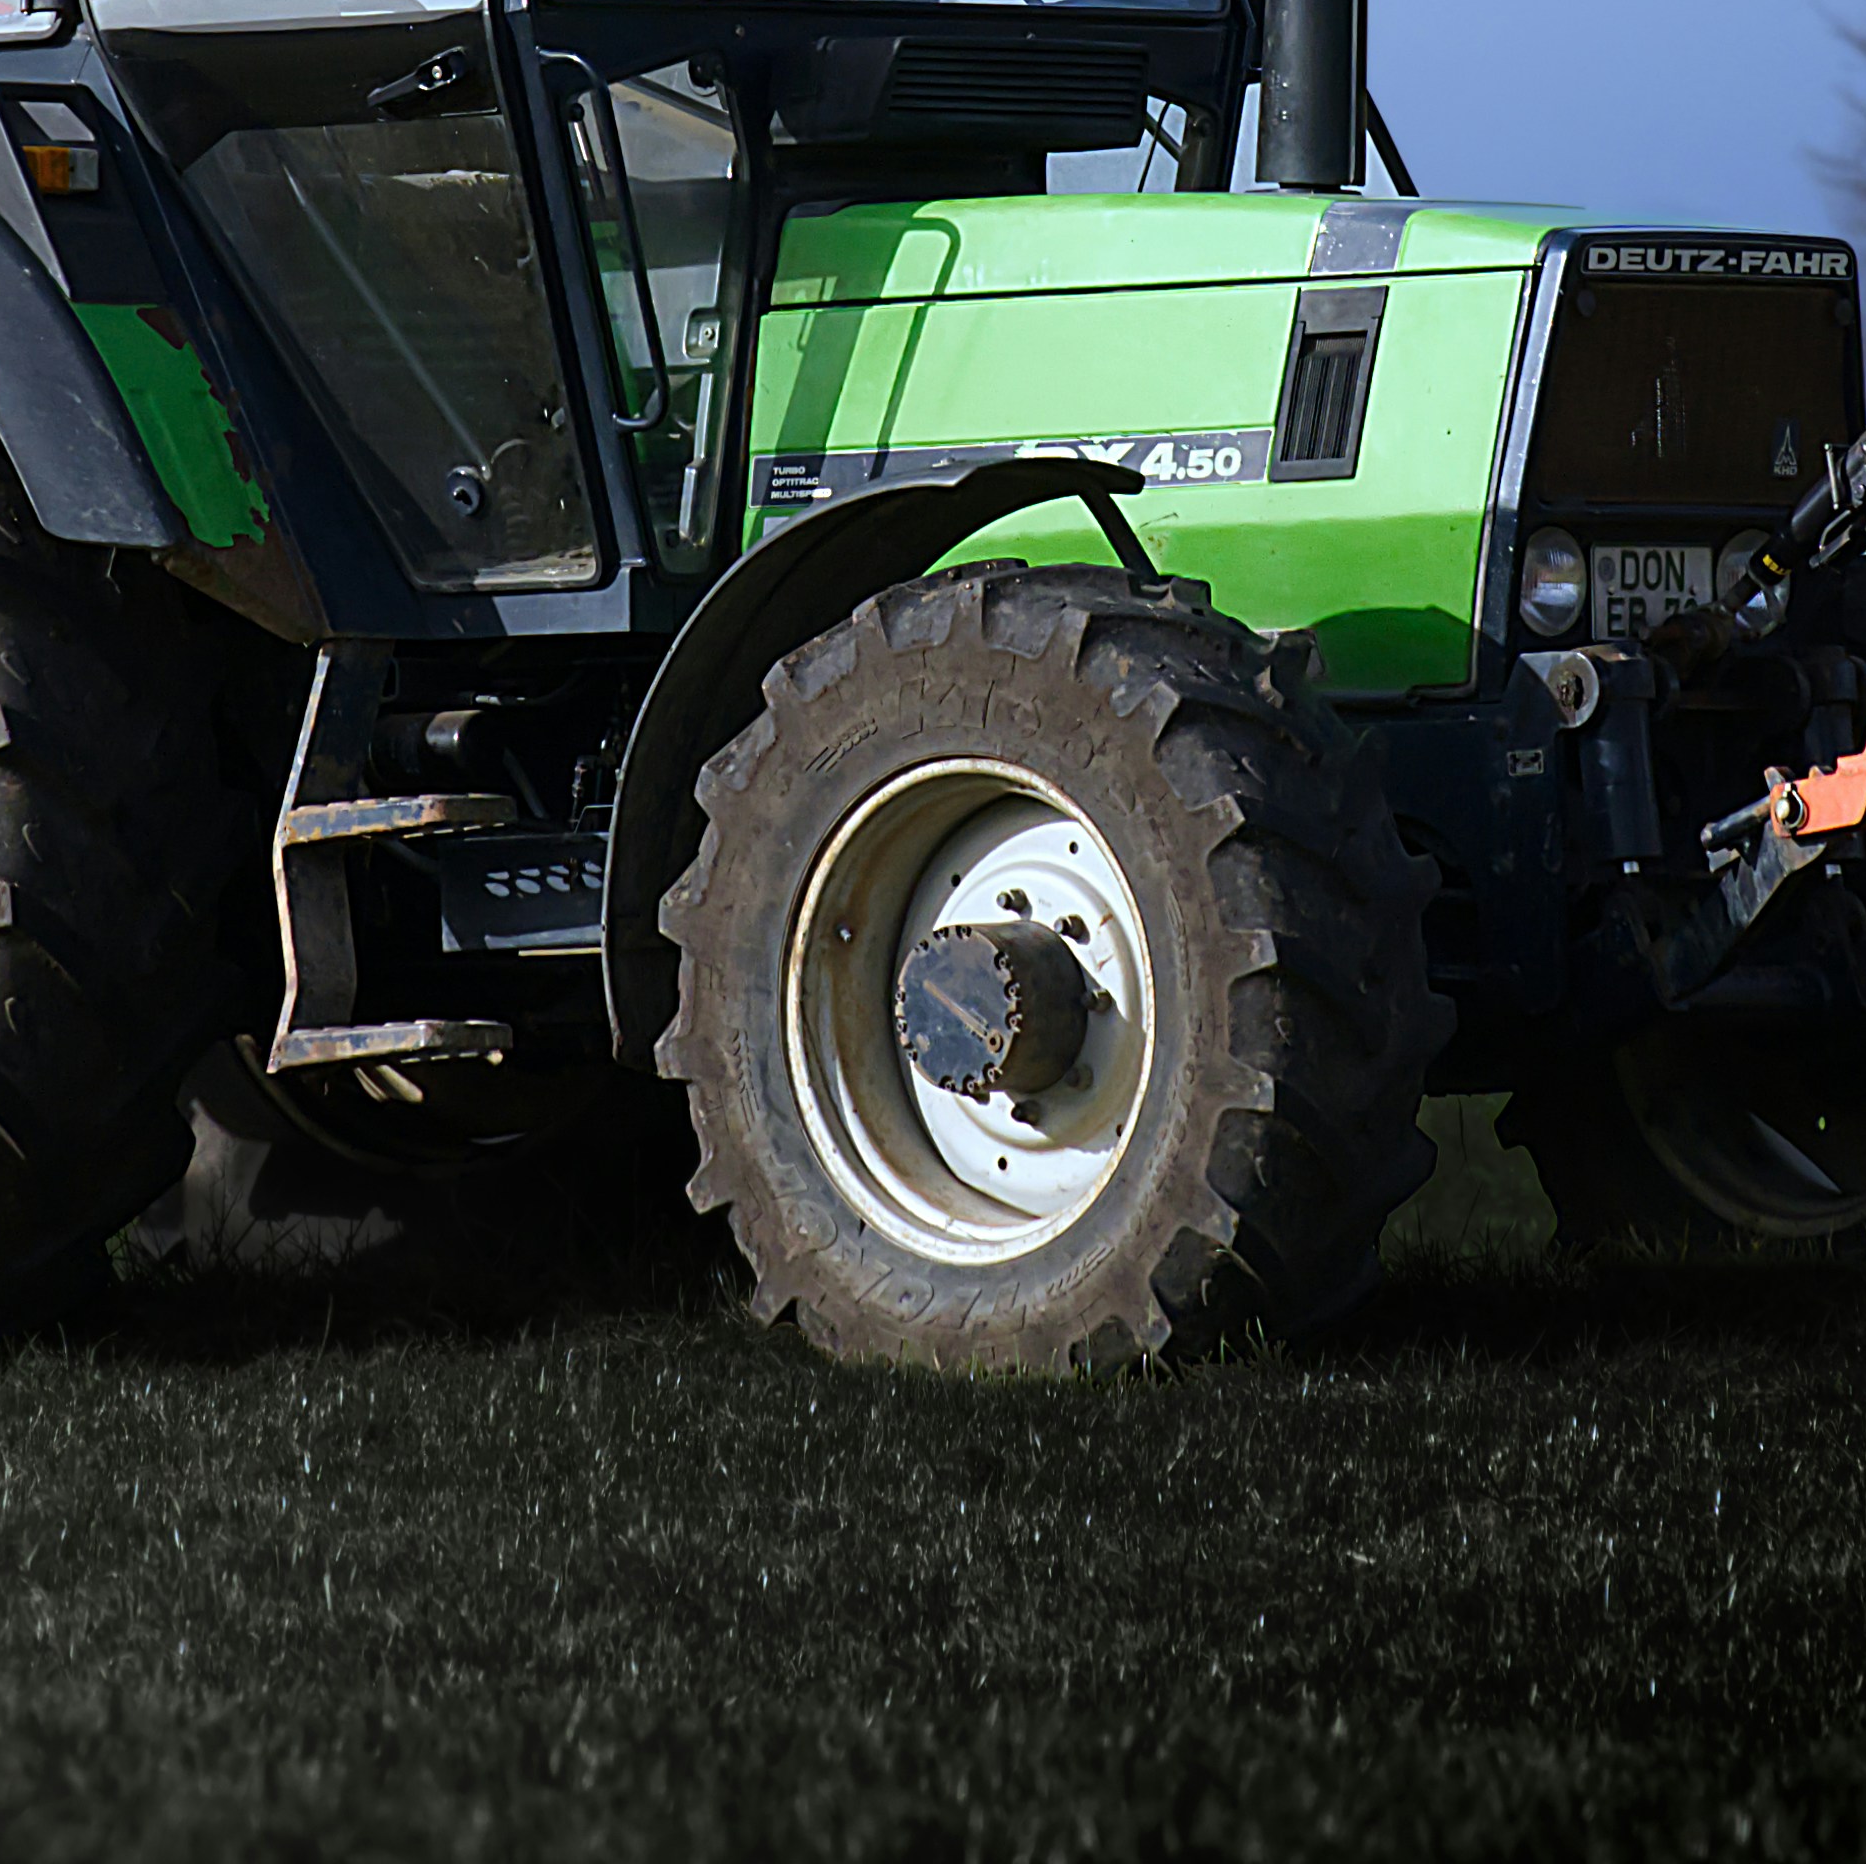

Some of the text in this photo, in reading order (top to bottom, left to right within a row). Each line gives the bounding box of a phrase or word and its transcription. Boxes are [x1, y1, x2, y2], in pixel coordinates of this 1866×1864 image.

[1140, 442, 1241, 481] 4.50
[773, 466, 806, 475] TURBO
[1774, 466, 1797, 476] KHD
[772, 477, 819, 486] OPTITRAC
[1621, 550, 1685, 592] DON
